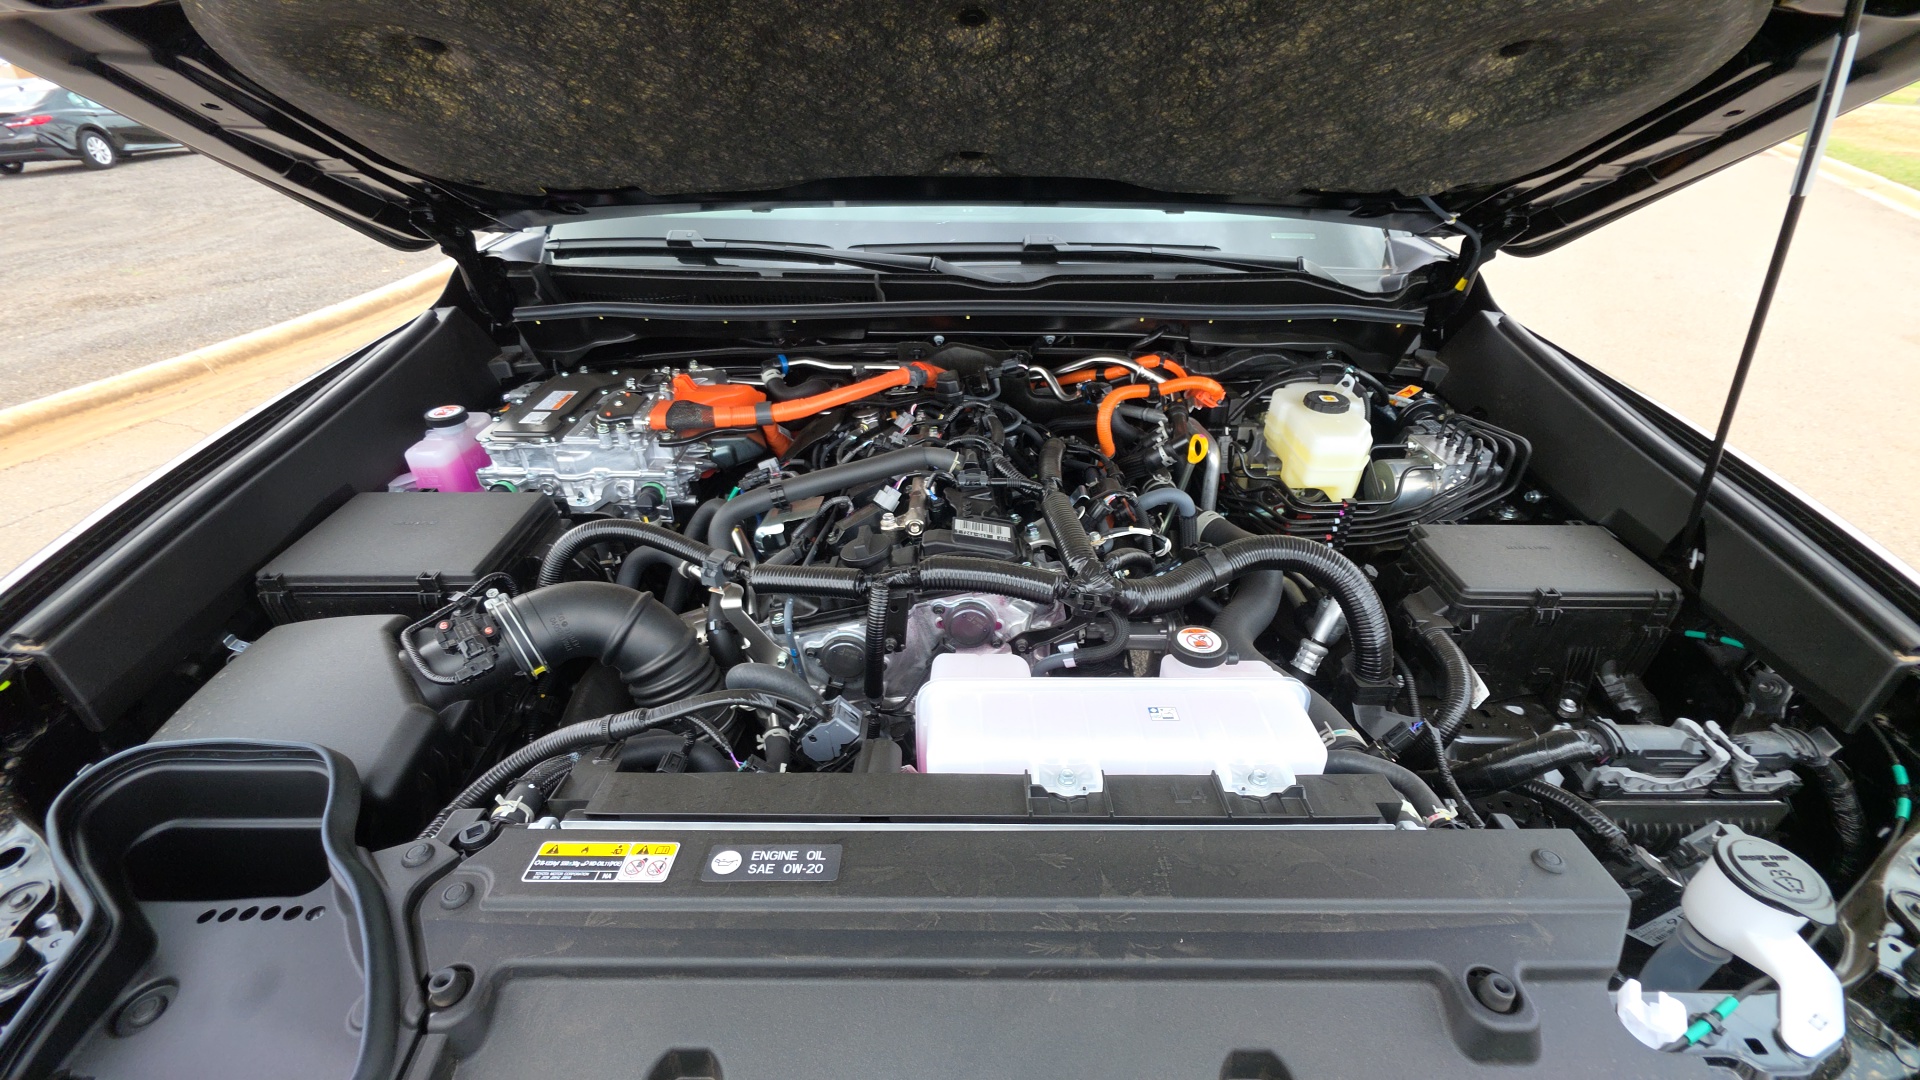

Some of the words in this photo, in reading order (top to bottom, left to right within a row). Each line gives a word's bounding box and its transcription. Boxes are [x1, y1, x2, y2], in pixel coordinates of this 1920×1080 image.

[751, 850, 799, 860] ENGINE
[806, 850, 826, 860] OIL
[747, 863, 776, 874] SAE
[783, 863, 824, 874] 0W-20
